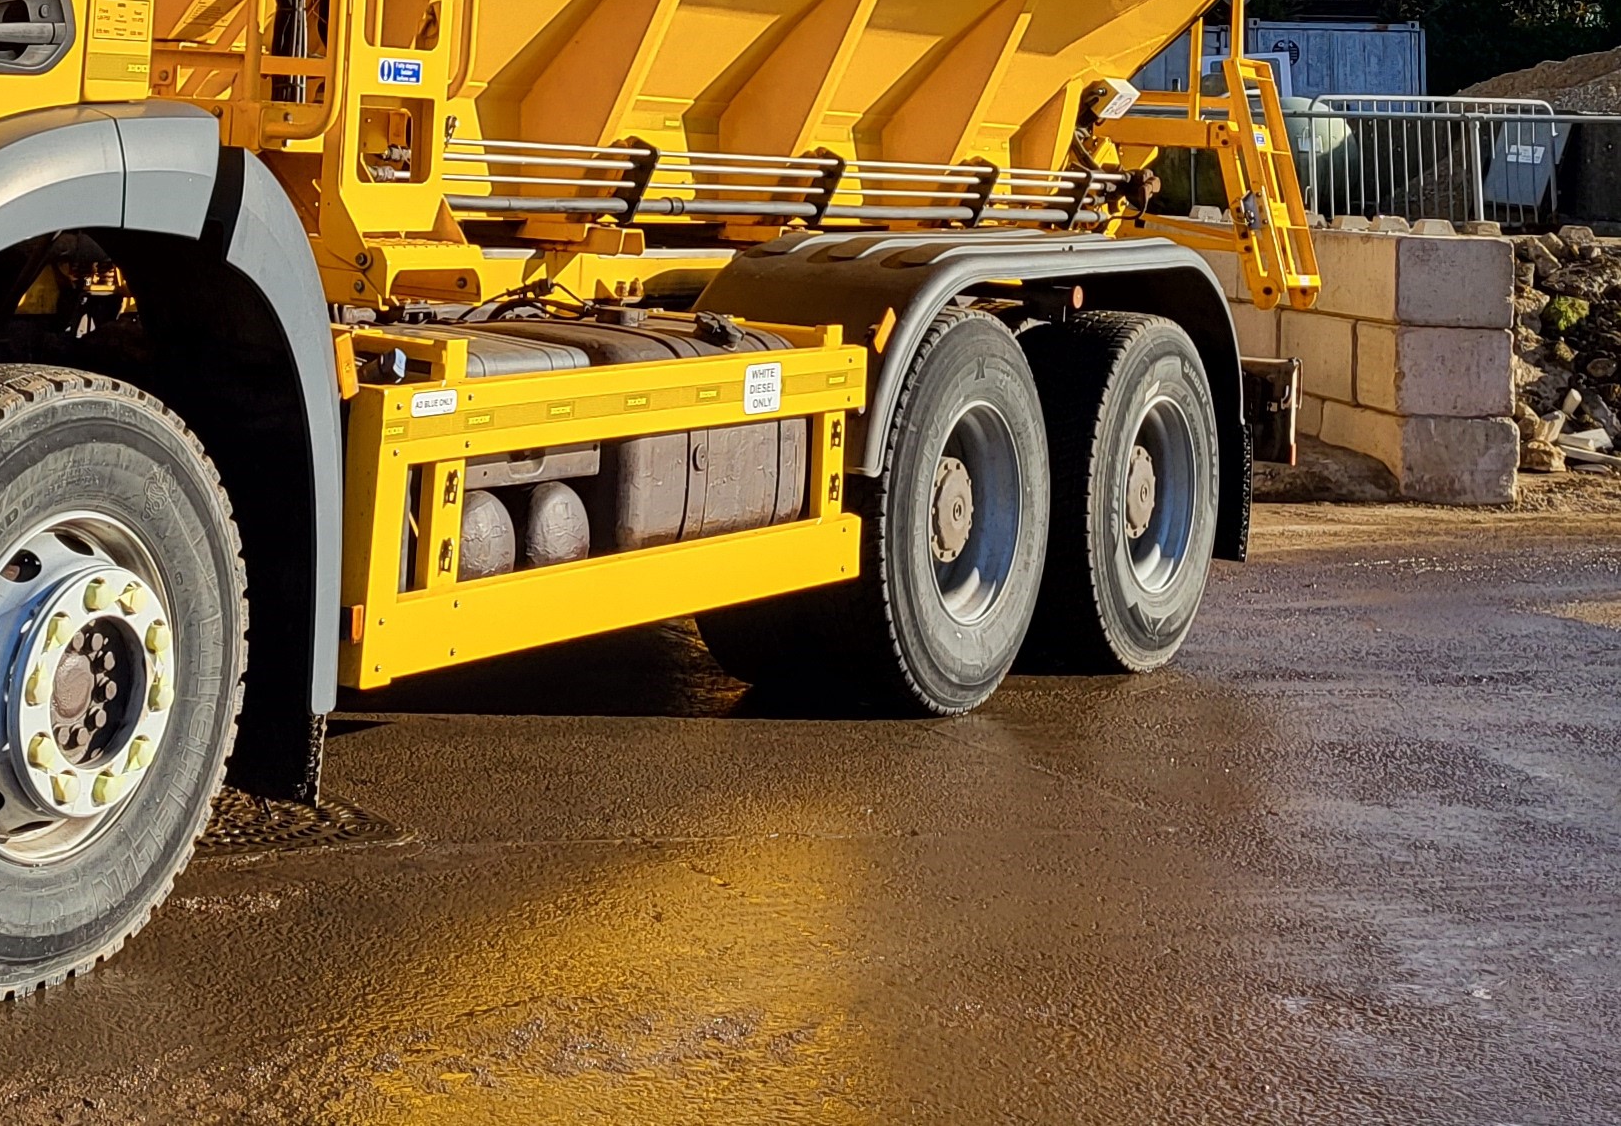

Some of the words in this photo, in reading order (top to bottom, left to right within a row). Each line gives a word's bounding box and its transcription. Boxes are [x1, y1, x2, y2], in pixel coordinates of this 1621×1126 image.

[127, 63, 150, 73] ECO
[751, 368, 776, 379] WHITE
[749, 382, 776, 394] DIESEL
[424, 398, 439, 409] BLUE
[439, 397, 454, 407] ONLY
[752, 396, 773, 408] ONLY
[385, 426, 404, 435] CON
